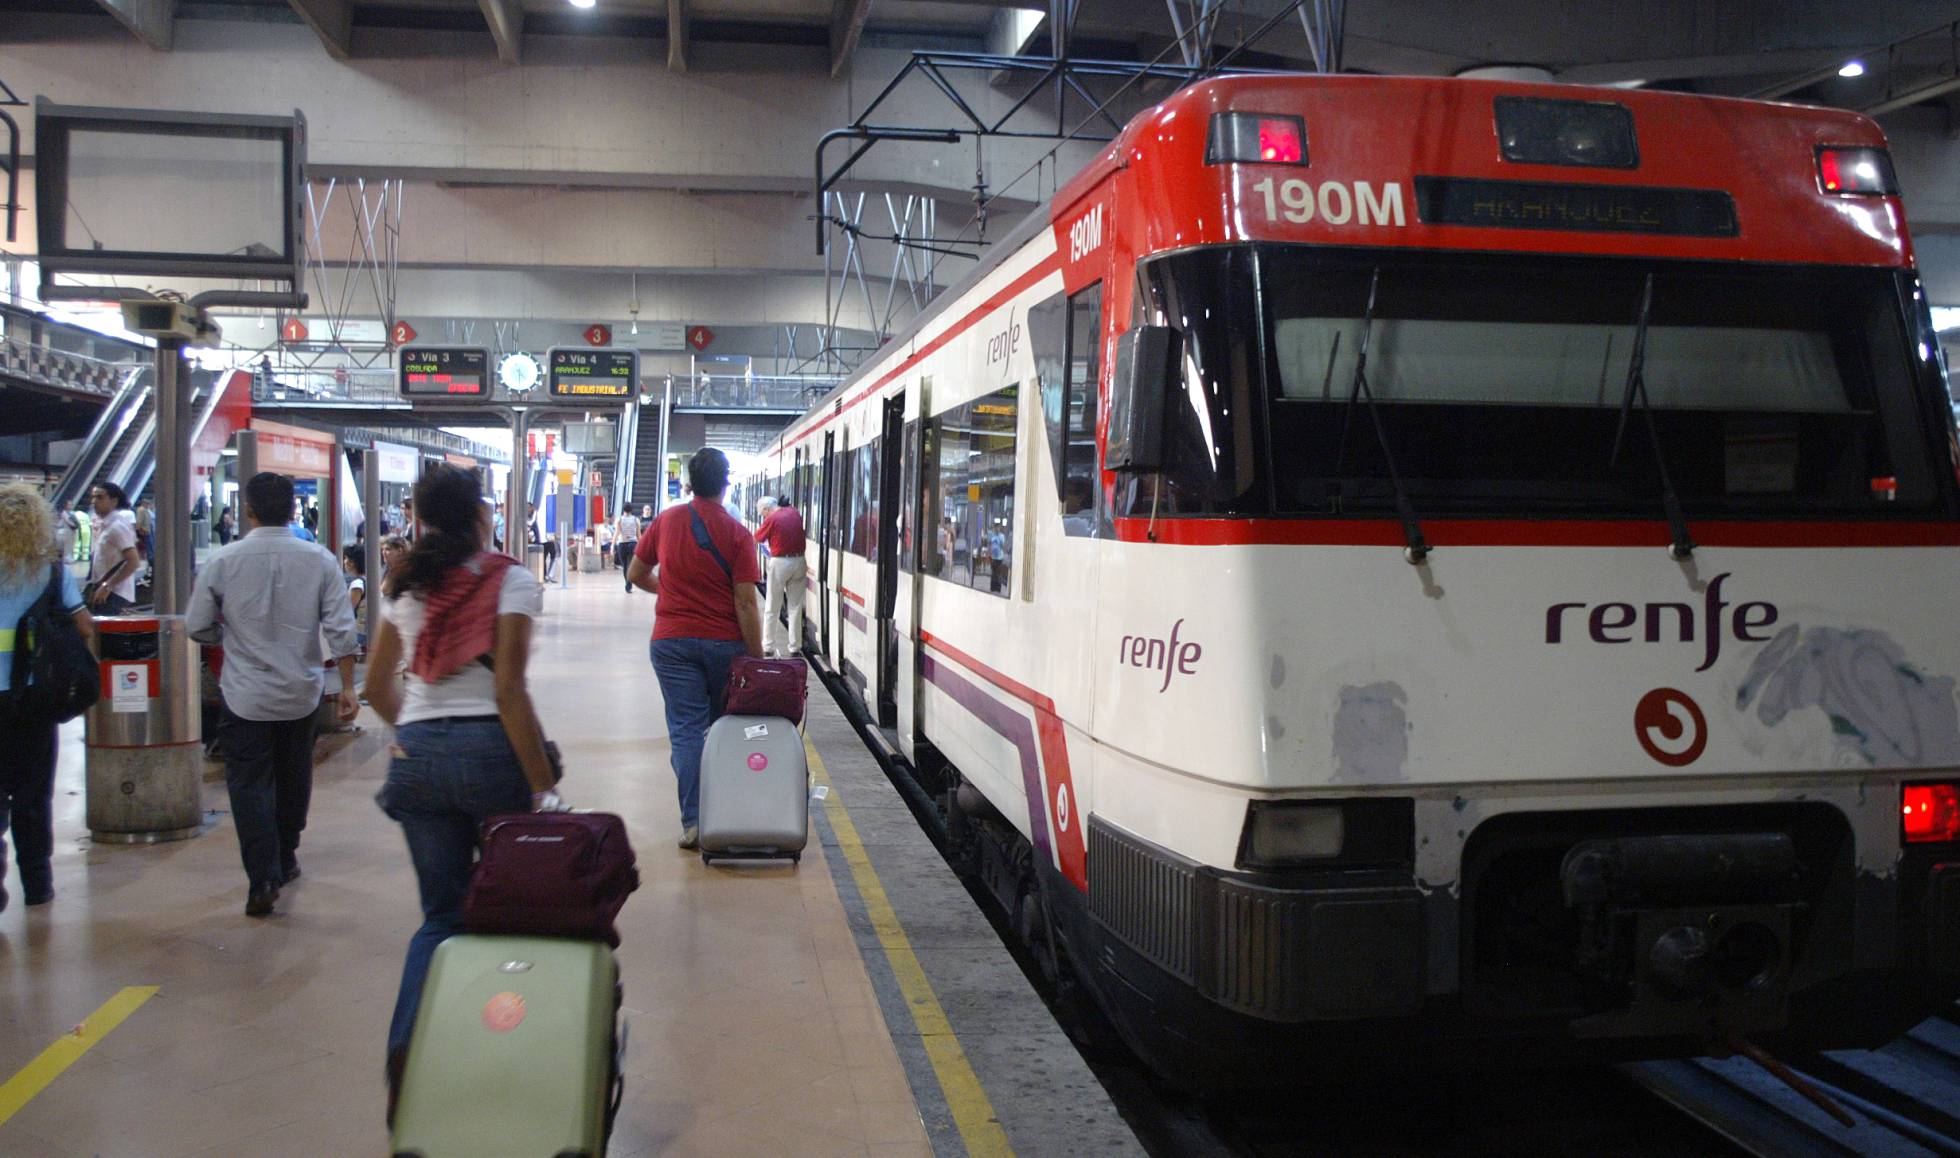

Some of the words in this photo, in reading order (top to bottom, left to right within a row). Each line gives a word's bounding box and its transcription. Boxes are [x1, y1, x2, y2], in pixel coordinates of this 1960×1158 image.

[1252, 177, 1407, 227] 190M
[1069, 203, 1103, 263] 190M
[290, 326, 297, 339] 1
[397, 327, 406, 340] 2
[593, 329, 601, 342] 3
[694, 331, 704, 344] 4
[986, 305, 1021, 378] renfe
[442, 351, 450, 363] 3
[590, 354, 597, 365] 4
[1545, 572, 1779, 674] renfe
[1119, 618, 1202, 693] renfe
